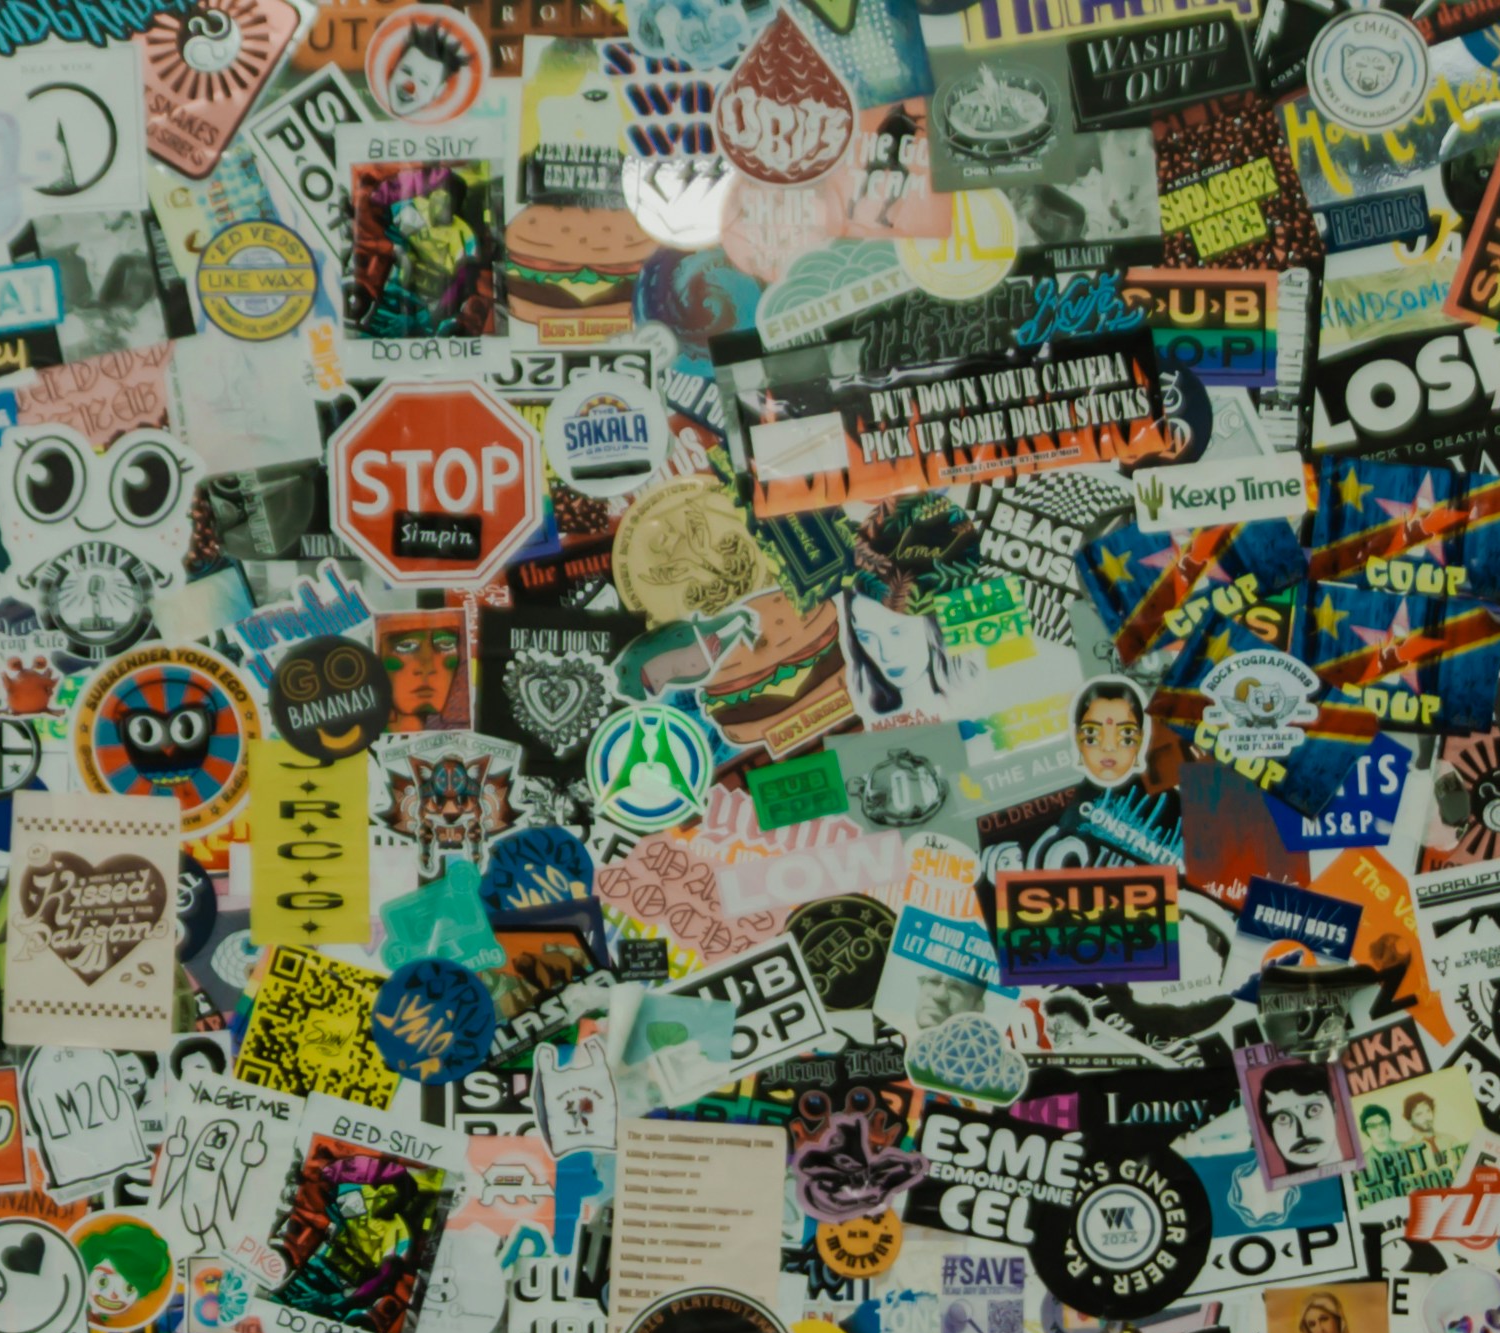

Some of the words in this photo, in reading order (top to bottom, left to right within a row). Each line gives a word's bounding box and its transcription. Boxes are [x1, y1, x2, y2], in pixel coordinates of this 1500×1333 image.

[1087, 21, 1226, 74] WASHED
[1124, 63, 1193, 103] OUT
[871, 388, 914, 422] PUT
[917, 377, 978, 414] DOWN
[981, 368, 1039, 403] YOUR
[1042, 352, 1128, 392] CAMERA
[562, 417, 649, 450] SAKALA
[861, 428, 914, 463] PICK
[916, 420, 946, 454] UP
[950, 410, 1006, 446] SOME
[1009, 402, 1074, 438] DRUM
[1075, 387, 1150, 425] STICKS
[350, 450, 520, 515] STOP
[1168, 480, 1236, 511] Kexp
[1241, 478, 1301, 501] Time
[1416, 871, 1500, 896] CORRUPT
[924, 1114, 1087, 1188] ESMÉ
[940, 1188, 1035, 1244] CEL
[942, 1256, 1025, 1286] #SAVE
